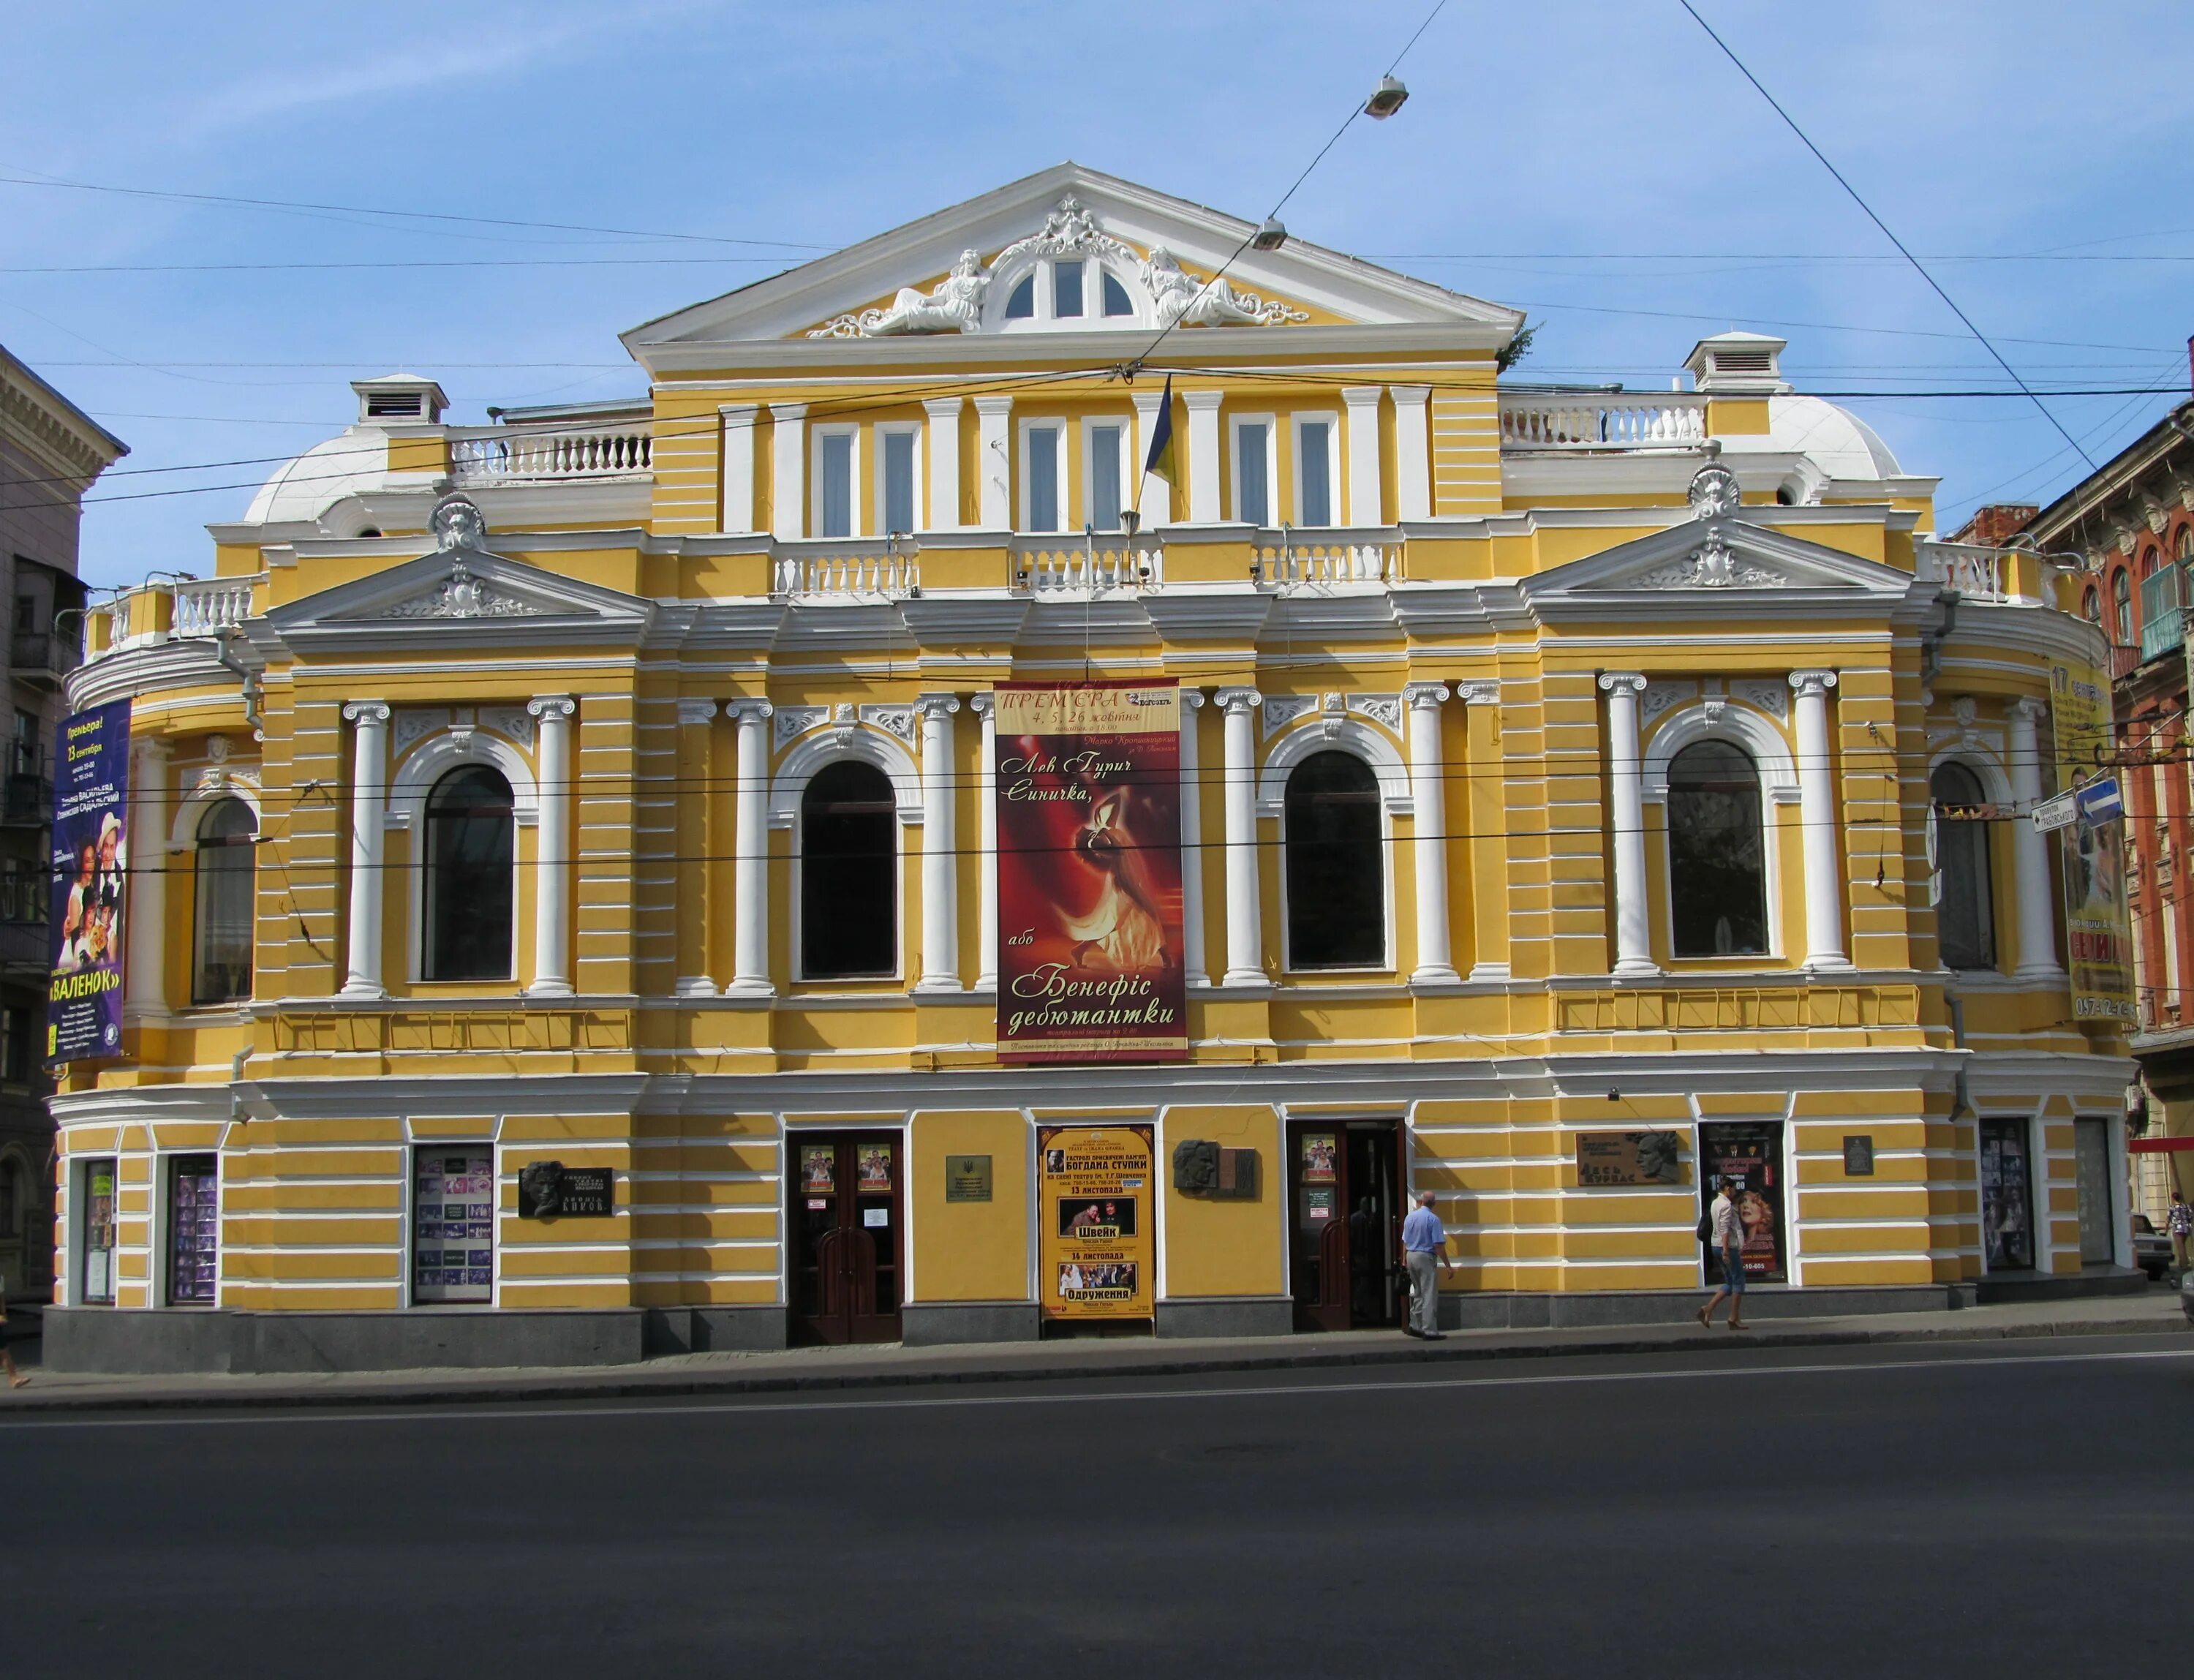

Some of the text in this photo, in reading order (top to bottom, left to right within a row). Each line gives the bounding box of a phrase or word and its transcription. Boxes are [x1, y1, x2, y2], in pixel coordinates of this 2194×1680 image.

[2052, 666, 2068, 694] 17
[1000, 691, 1118, 709] ПРЕМ'ЄРА
[1068, 711, 1085, 723] 26
[1090, 710, 1139, 723] жовтня
[67, 717, 103, 740] Премьера!
[67, 742, 102, 763] 23 сентября
[1000, 750, 1131, 779] Лев Гурич
[1000, 778, 1093, 803] Синичка,
[1008, 927, 1036, 946] або
[50, 968, 120, 1001] «ВАЛЕНОК»
[1011, 963, 1152, 1006] Бенефіс
[1008, 996, 1174, 1036] дебютантки
[1066, 1160, 1147, 1170] БОГДАНА СТУПКИ
[1082, 1186, 1123, 1194] листопада
[1079, 1227, 1117, 1238] Швейк
[1072, 1252, 1124, 1260] 14 листопада
[1068, 1289, 1129, 1300] Одруження
